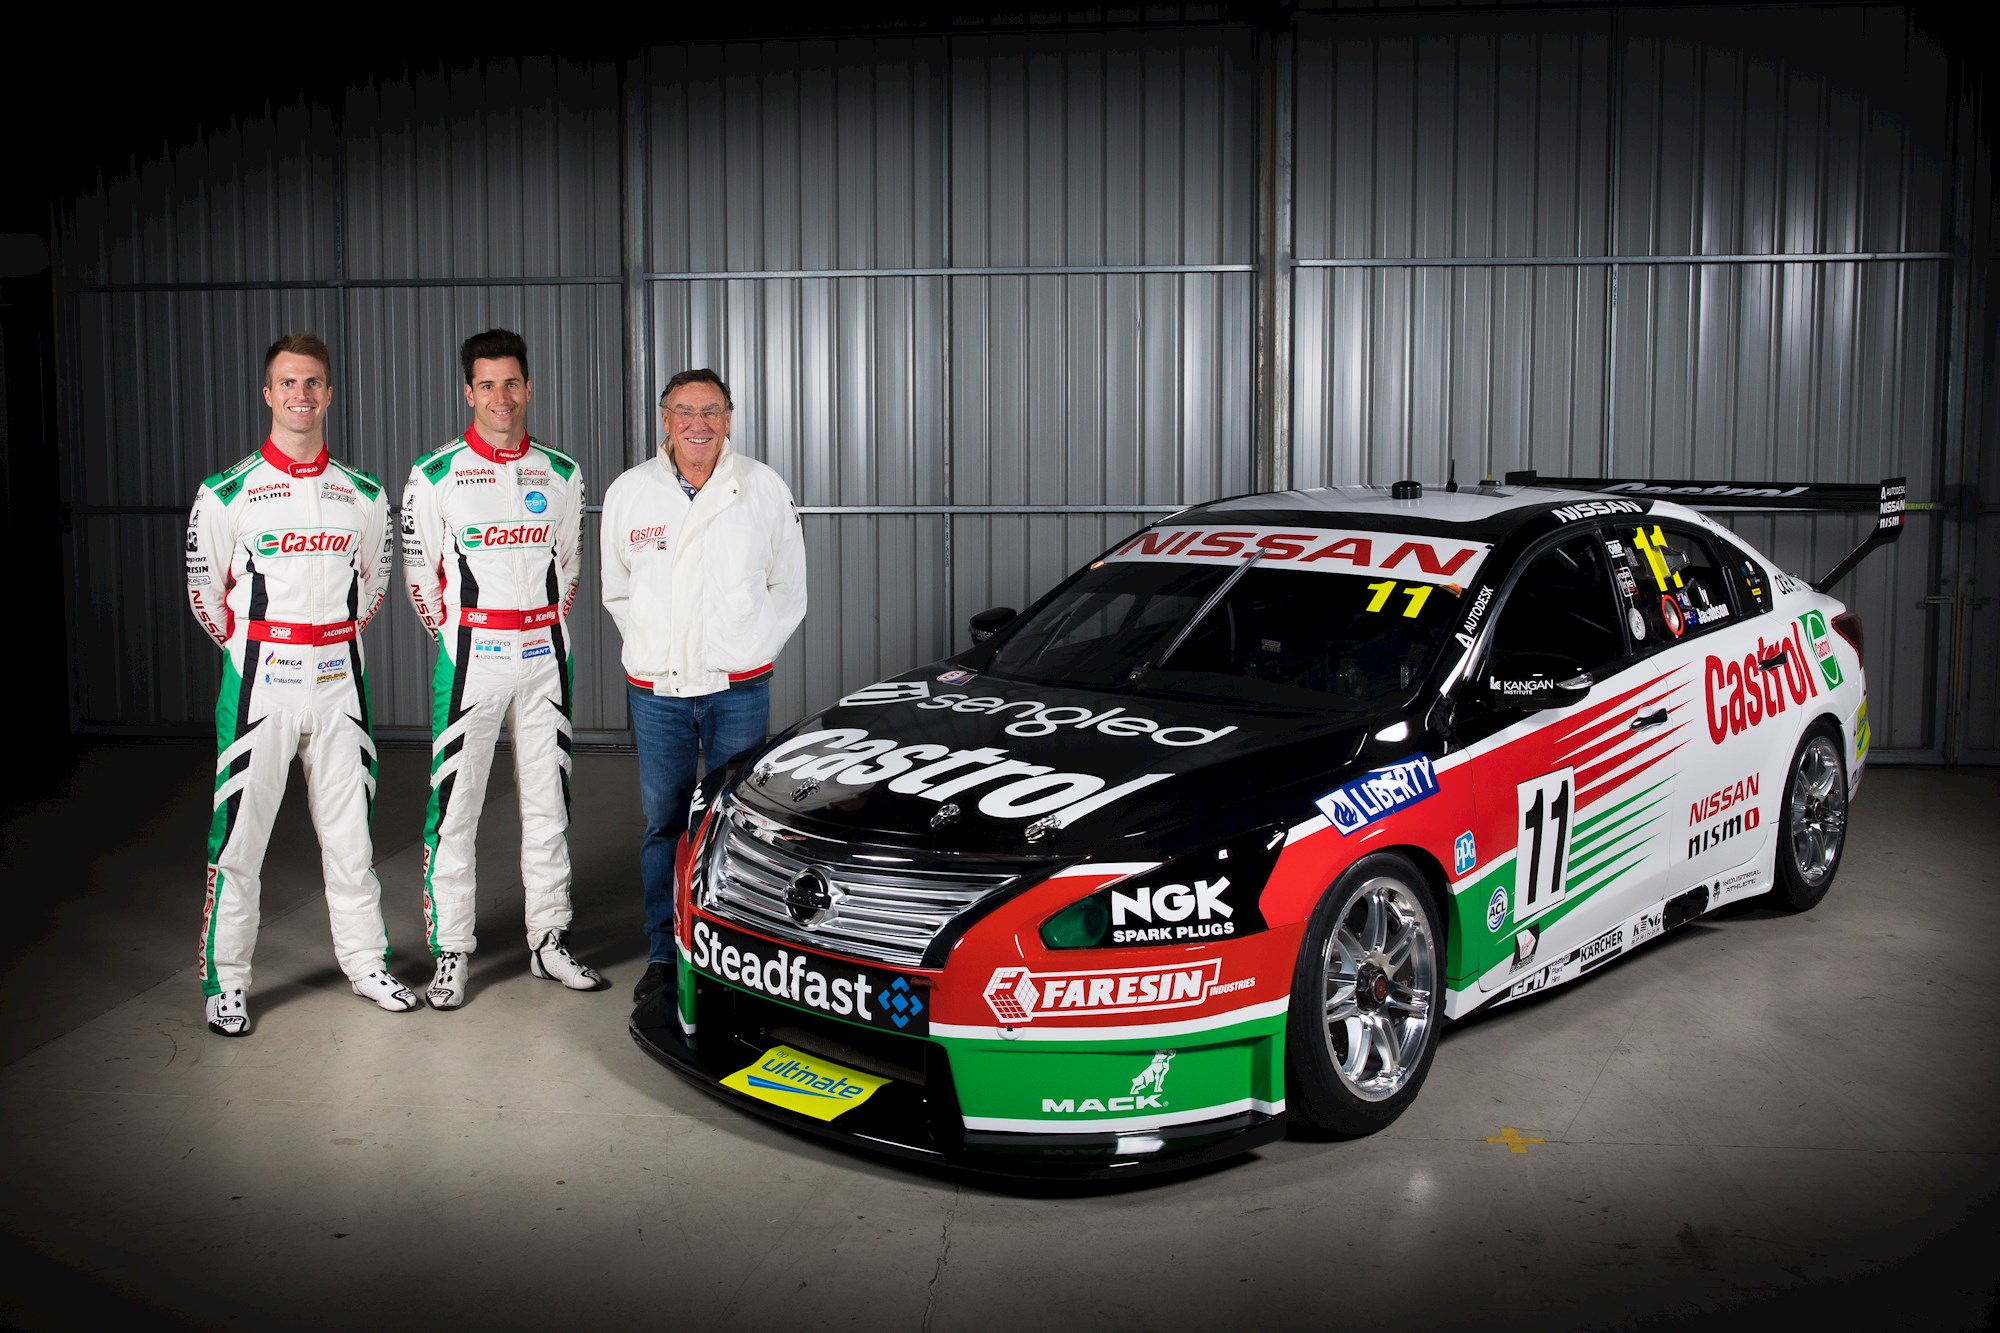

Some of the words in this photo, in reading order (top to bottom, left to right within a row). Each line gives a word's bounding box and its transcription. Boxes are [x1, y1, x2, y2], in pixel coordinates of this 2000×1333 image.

[426, 460, 444, 475] OMP
[455, 468, 495, 477] NISSAN
[523, 468, 546, 477] Castrol
[555, 458, 572, 470] OMP
[220, 481, 238, 497] OMP
[248, 482, 290, 496] NISSAN
[330, 483, 353, 495] Castrol
[358, 480, 378, 494] OMP
[457, 478, 496, 486] nismo
[249, 491, 291, 503] nismo
[1880, 499, 1905, 514] NISSAN
[1551, 500, 1643, 523] NISSAN
[281, 531, 352, 553] Castrol
[484, 524, 549, 546] Castrol
[630, 524, 666, 543] Castrol
[1116, 531, 1478, 576] NISSAN
[1633, 525, 1684, 592] 11
[1366, 581, 1433, 618] 11
[191, 590, 227, 644] NISSA
[468, 612, 488, 624] OMP
[524, 615, 534, 624] R.
[535, 611, 556, 622] Kelly
[1463, 586, 1493, 634] AUTODESK
[269, 627, 291, 639] OMP
[322, 626, 353, 638] JACOBSON
[474, 639, 511, 647] GoPro
[1814, 637, 1831, 660] Castrol
[317, 658, 346, 670] EXEDY
[1503, 679, 1553, 691] KANGAN
[1705, 622, 1818, 745] Castrol
[917, 693, 1238, 747] sengled
[753, 728, 1176, 830] Castrol
[1350, 756, 1433, 817] LIBERTY
[1689, 772, 1760, 827] NISSAN
[1525, 780, 1568, 906] 11
[1688, 807, 1760, 860] nismo
[1722, 869, 1761, 887] INDUSTRIAL
[1726, 878, 1757, 894] ATHLETE
[1111, 876, 1234, 925] NGK
[1488, 900, 1506, 920] ACL
[1113, 926, 1173, 942] SPARK
[1176, 922, 1235, 939] PLUGS
[1580, 930, 1623, 962] KÄRCHER
[693, 921, 872, 1021] Steadfast
[1041, 970, 1203, 1009] FARESIN
[1209, 977, 1256, 996] INDUSTRIES
[762, 1058, 864, 1098] ultimate
[1042, 1094, 1163, 1113] MACK
